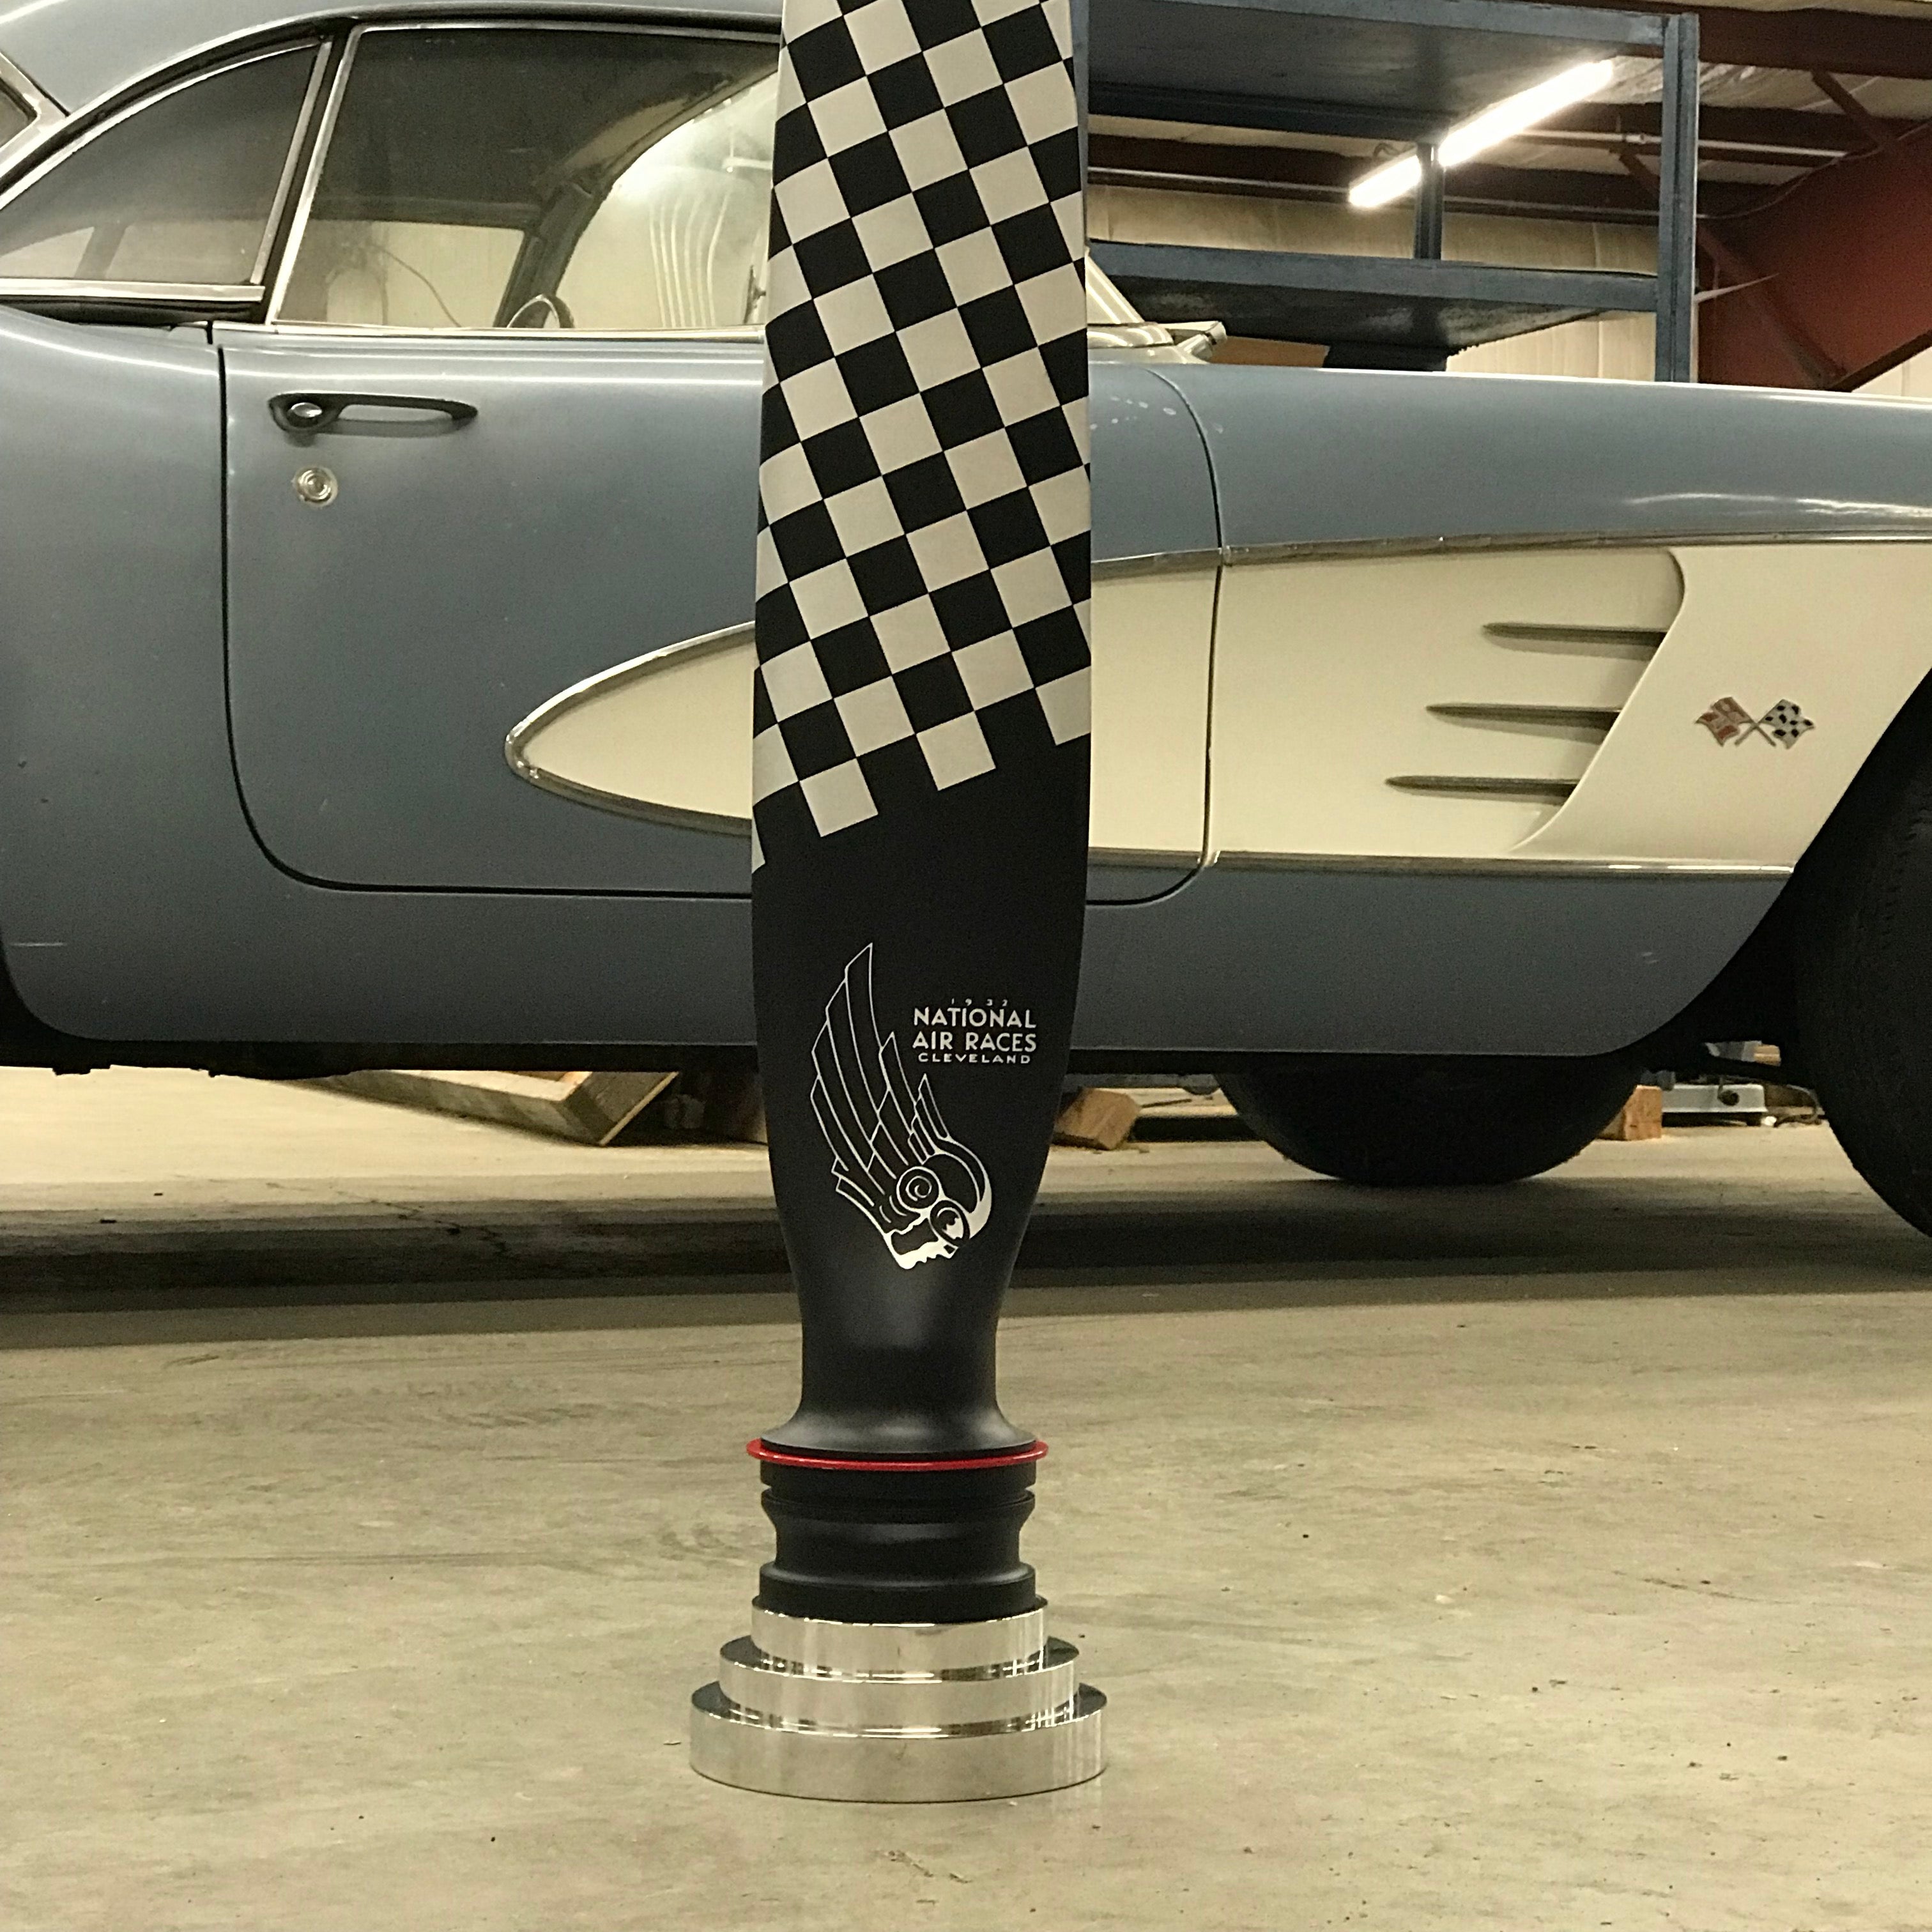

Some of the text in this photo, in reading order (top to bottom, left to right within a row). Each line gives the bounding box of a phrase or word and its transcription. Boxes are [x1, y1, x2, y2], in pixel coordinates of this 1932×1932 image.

[914, 1007, 1036, 1029] NATIONAL
[912, 1031, 1036, 1052] AIR RACES
[918, 1052, 1031, 1064] CLEVELAND
